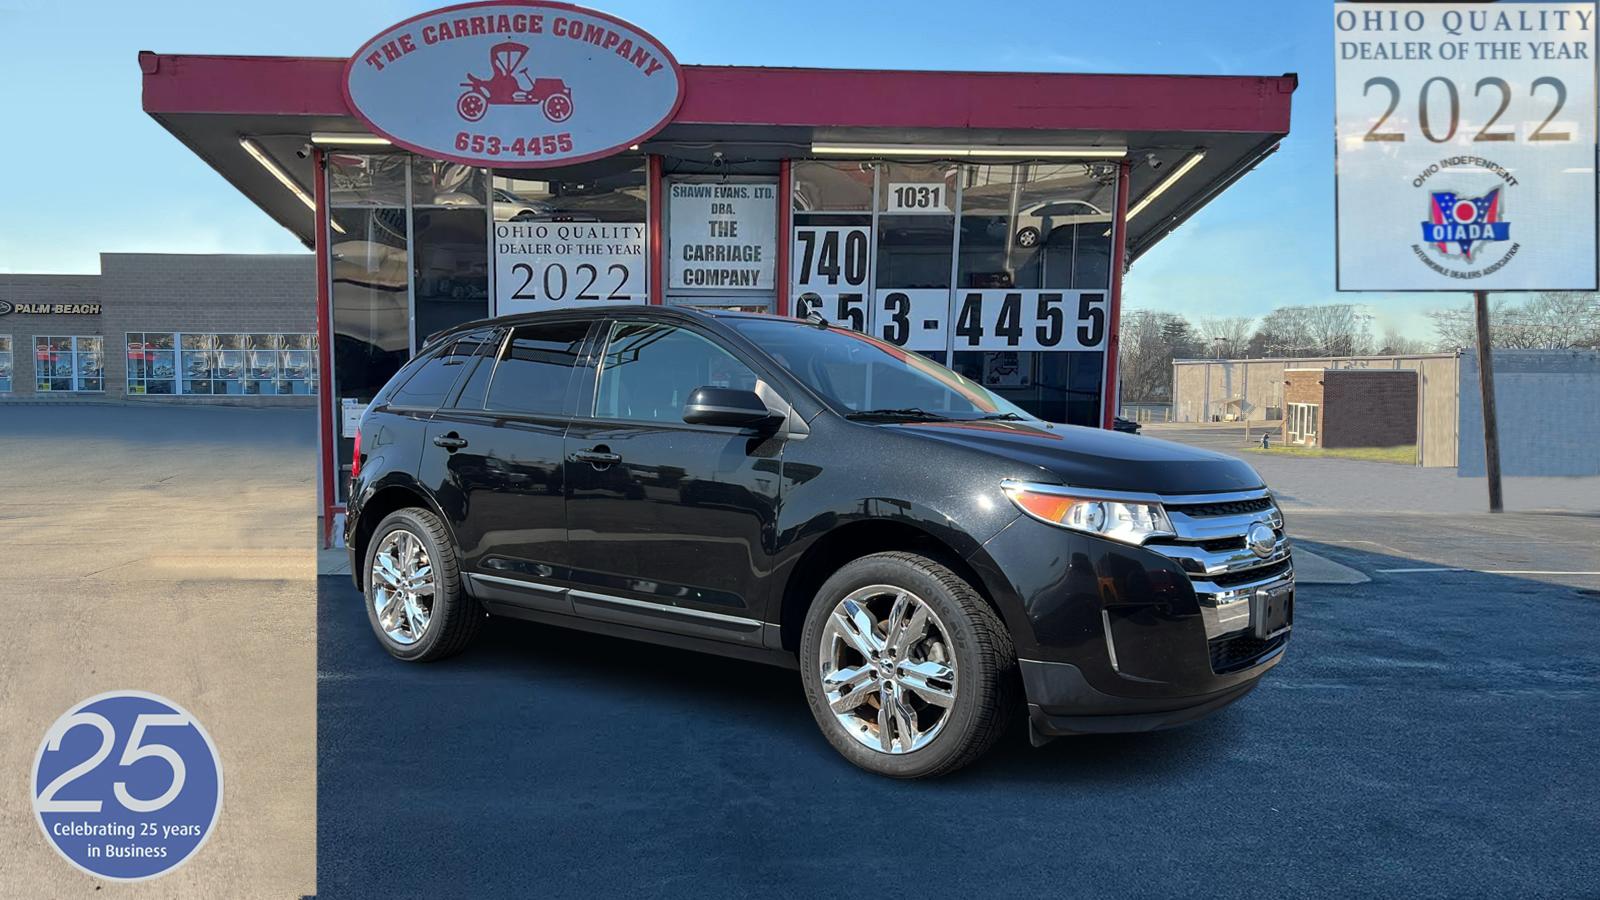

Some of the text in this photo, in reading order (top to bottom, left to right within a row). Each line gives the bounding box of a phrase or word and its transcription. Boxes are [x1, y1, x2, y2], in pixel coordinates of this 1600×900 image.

[1336, 10, 1593, 35] OHIO QUALITY
[365, 14, 663, 76] THE CARRIAGE COMPANY
[1340, 41, 1589, 60] DEALER OF THE YEAR
[1363, 76, 1571, 143] 2022
[455, 132, 573, 157] 653-4455
[1412, 156, 1519, 188] OHIO INDEPENDENT
[673, 186, 711, 198] SHAWN
[754, 187, 775, 199] LTD.
[894, 186, 940, 208] 1031
[711, 203, 736, 215] DBA.
[497, 226, 644, 240] OHIO QUALITY
[708, 221, 738, 238] THE
[1432, 224, 1495, 241] OIADA
[499, 244, 642, 255] DEALER OF THE YEAR
[683, 244, 762, 262] CARRIAGE
[798, 230, 868, 286] 740
[1411, 242, 1521, 280] AUTOMOBILE DEALERS ASSOCIATION
[511, 263, 632, 301] 2022
[683, 269, 761, 286] COMPANY
[14, 303, 101, 314] PALM BEACH
